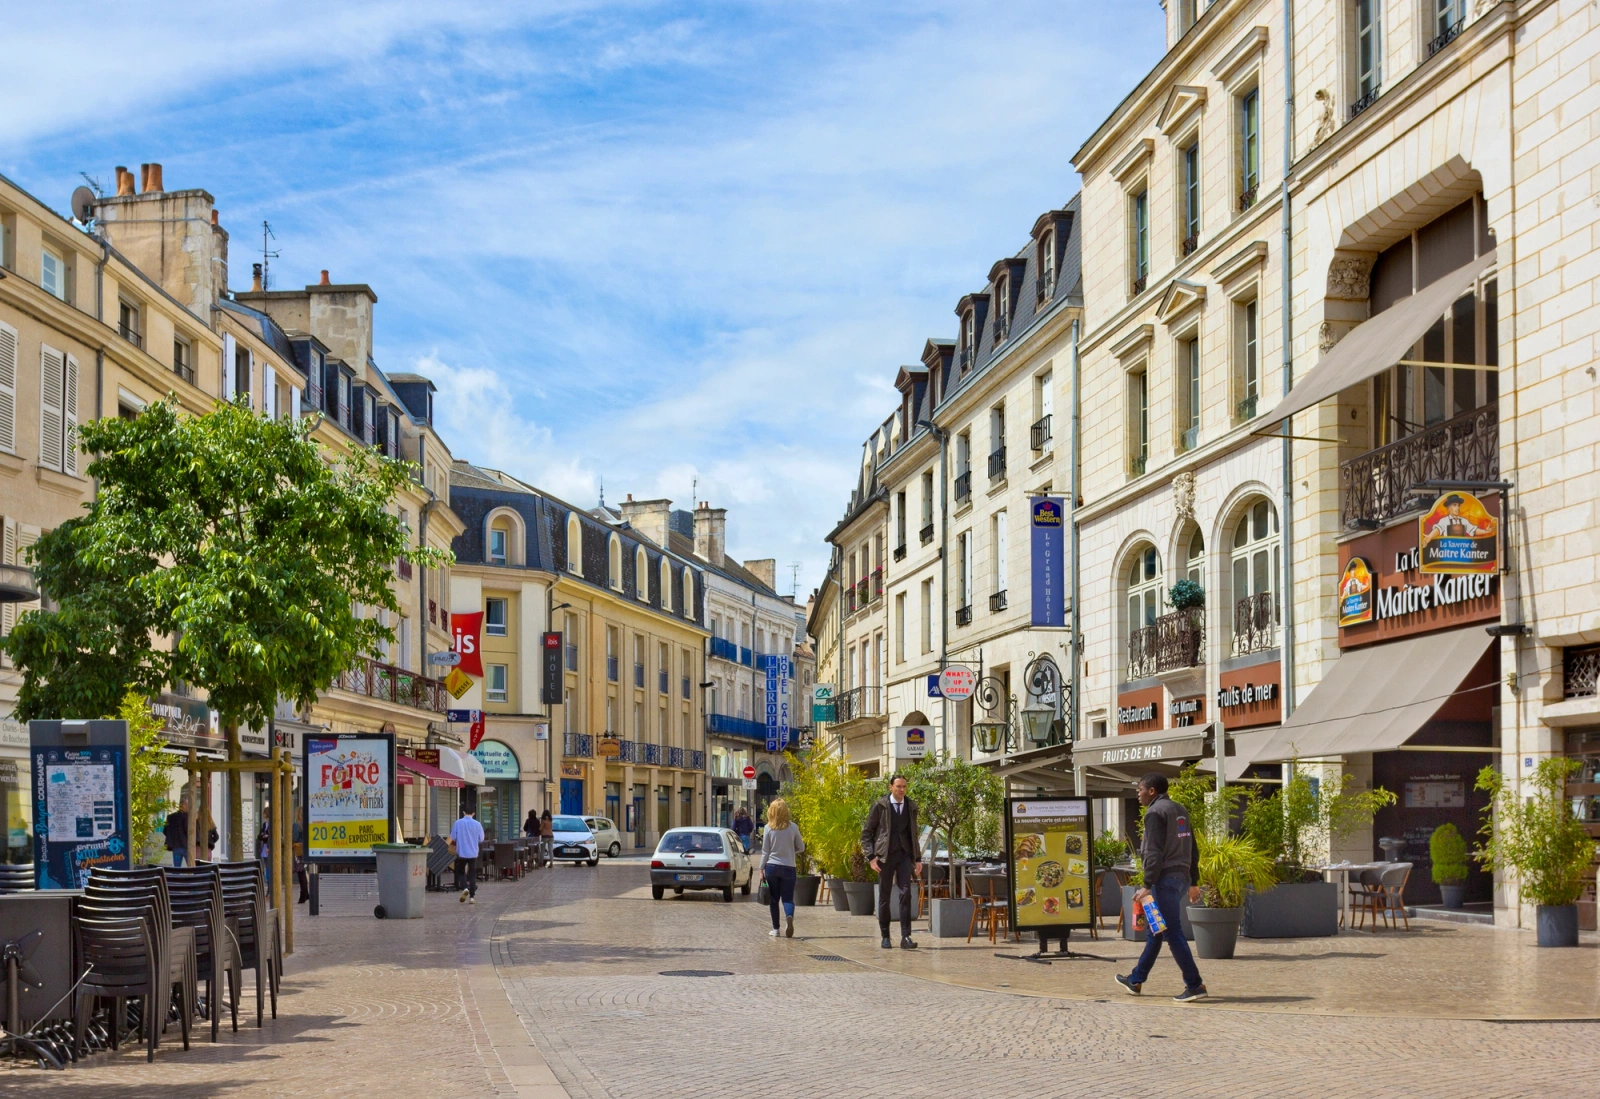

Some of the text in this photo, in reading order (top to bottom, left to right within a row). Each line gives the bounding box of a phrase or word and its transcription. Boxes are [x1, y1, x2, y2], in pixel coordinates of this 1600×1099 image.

[1034, 515, 1060, 524] Western
[1040, 509, 1054, 517] Best
[1045, 533, 1050, 547] Le
[1460, 549, 1489, 559] Kanter
[1395, 552, 1408, 573] La
[1376, 574, 1494, 620] Maître Kanter
[454, 681, 470, 697] PRESSE
[1217, 684, 1273, 708] Fruits de mer
[152, 703, 181, 718] COMPTOIR
[1118, 703, 1152, 724] Restaurant
[1169, 700, 1197, 715] Midi Minuit
[2, 724, 17, 732] Charles
[1102, 745, 1162, 762] FRUITS DE MER
[359, 797, 384, 809] POITIERS
[312, 826, 346, 841] 20 28
[359, 825, 374, 833] PARC
[349, 833, 385, 844] EXPOSITIONS
[76, 850, 98, 860] MIDI
